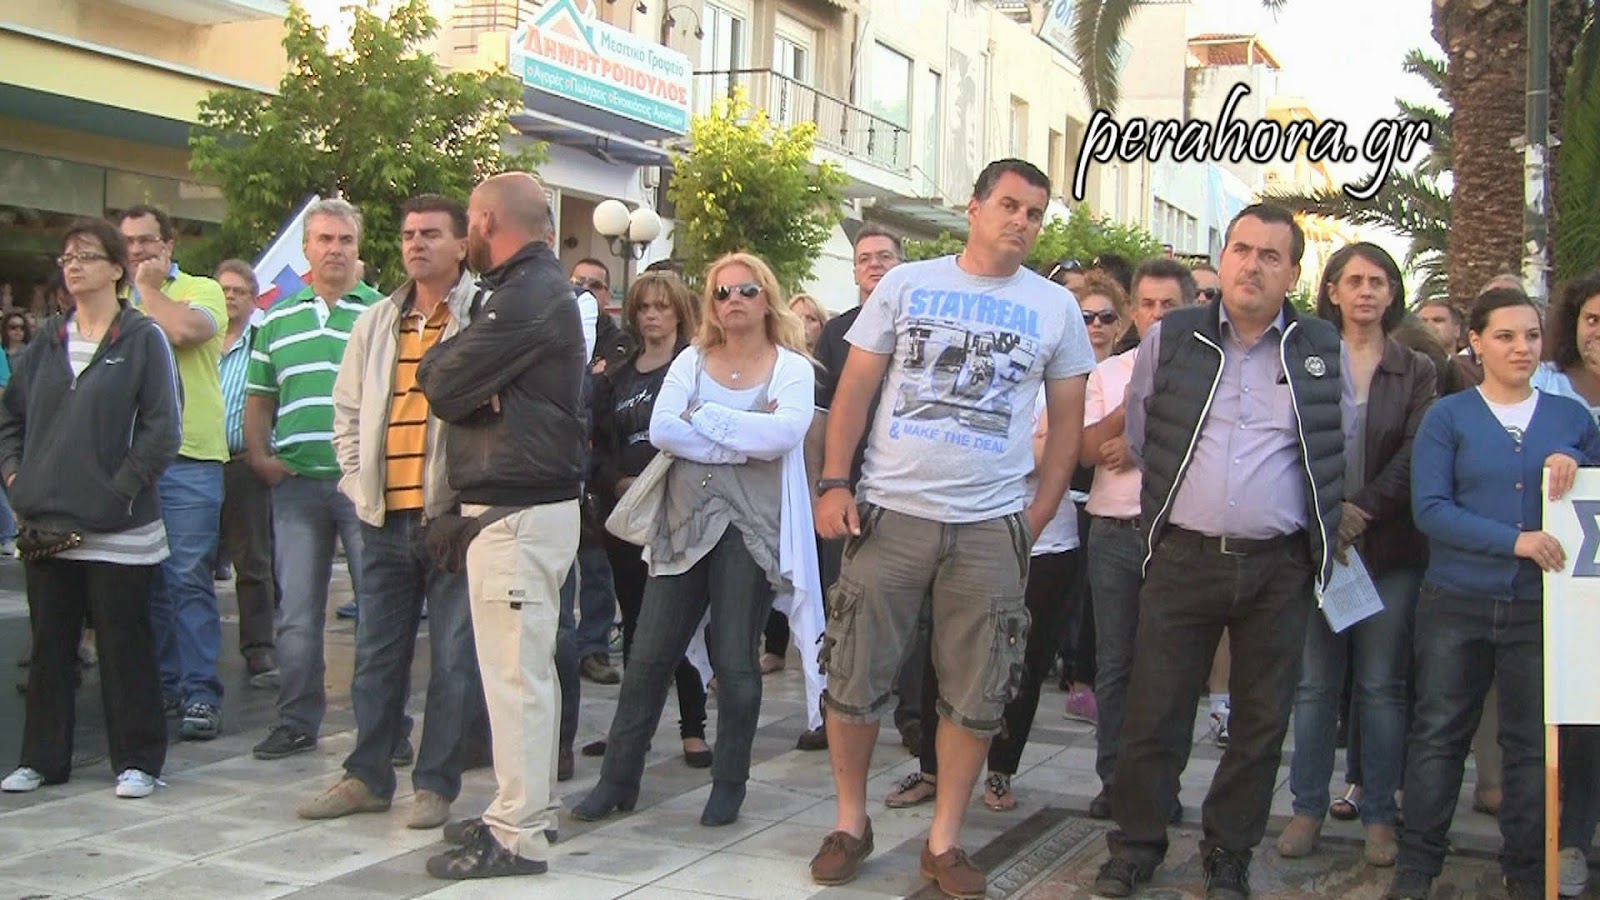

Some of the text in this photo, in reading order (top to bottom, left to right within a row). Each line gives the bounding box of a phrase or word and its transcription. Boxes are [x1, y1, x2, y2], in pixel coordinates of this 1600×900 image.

[524, 24, 688, 106] ΔΗΜΗΤΡΟΠΟΥΛΟΣ
[889, 421, 1007, 454] & MAKE THE DEAL
